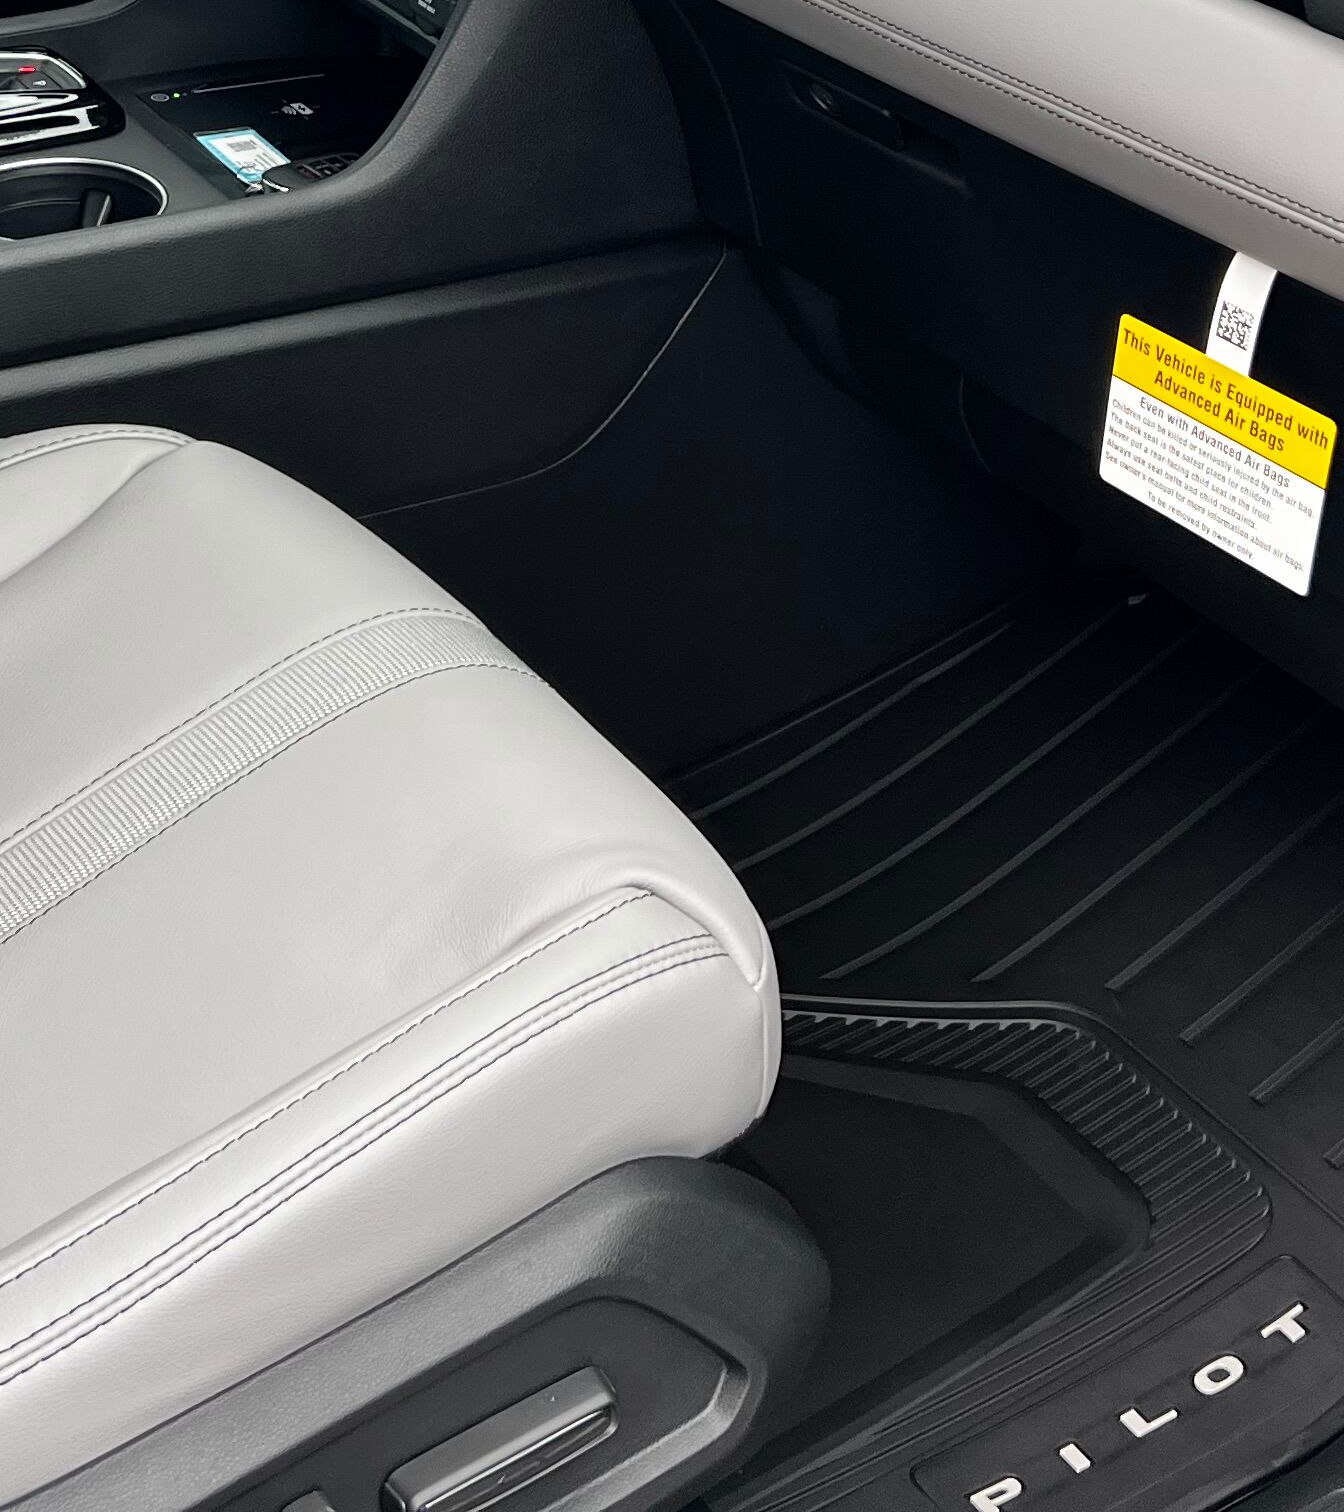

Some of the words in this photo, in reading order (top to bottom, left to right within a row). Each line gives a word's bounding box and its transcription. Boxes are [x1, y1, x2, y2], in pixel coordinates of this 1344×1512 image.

[1122, 328, 1151, 356] This
[1155, 345, 1206, 385] Vehicle
[1209, 374, 1222, 394] is
[1225, 382, 1292, 433] Equipped
[1296, 420, 1329, 450] with
[1139, 396, 1163, 418] Even
[1167, 410, 1188, 432] with
[1191, 424, 1242, 461] Advanced
[1244, 453, 1259, 471] Air
[1262, 463, 1289, 490] Bags
[1154, 369, 1221, 417] Advanced
[1224, 406, 1246, 431] Air
[1249, 420, 1285, 455] Bags
[969, 1301, 1307, 1512] PILOT
